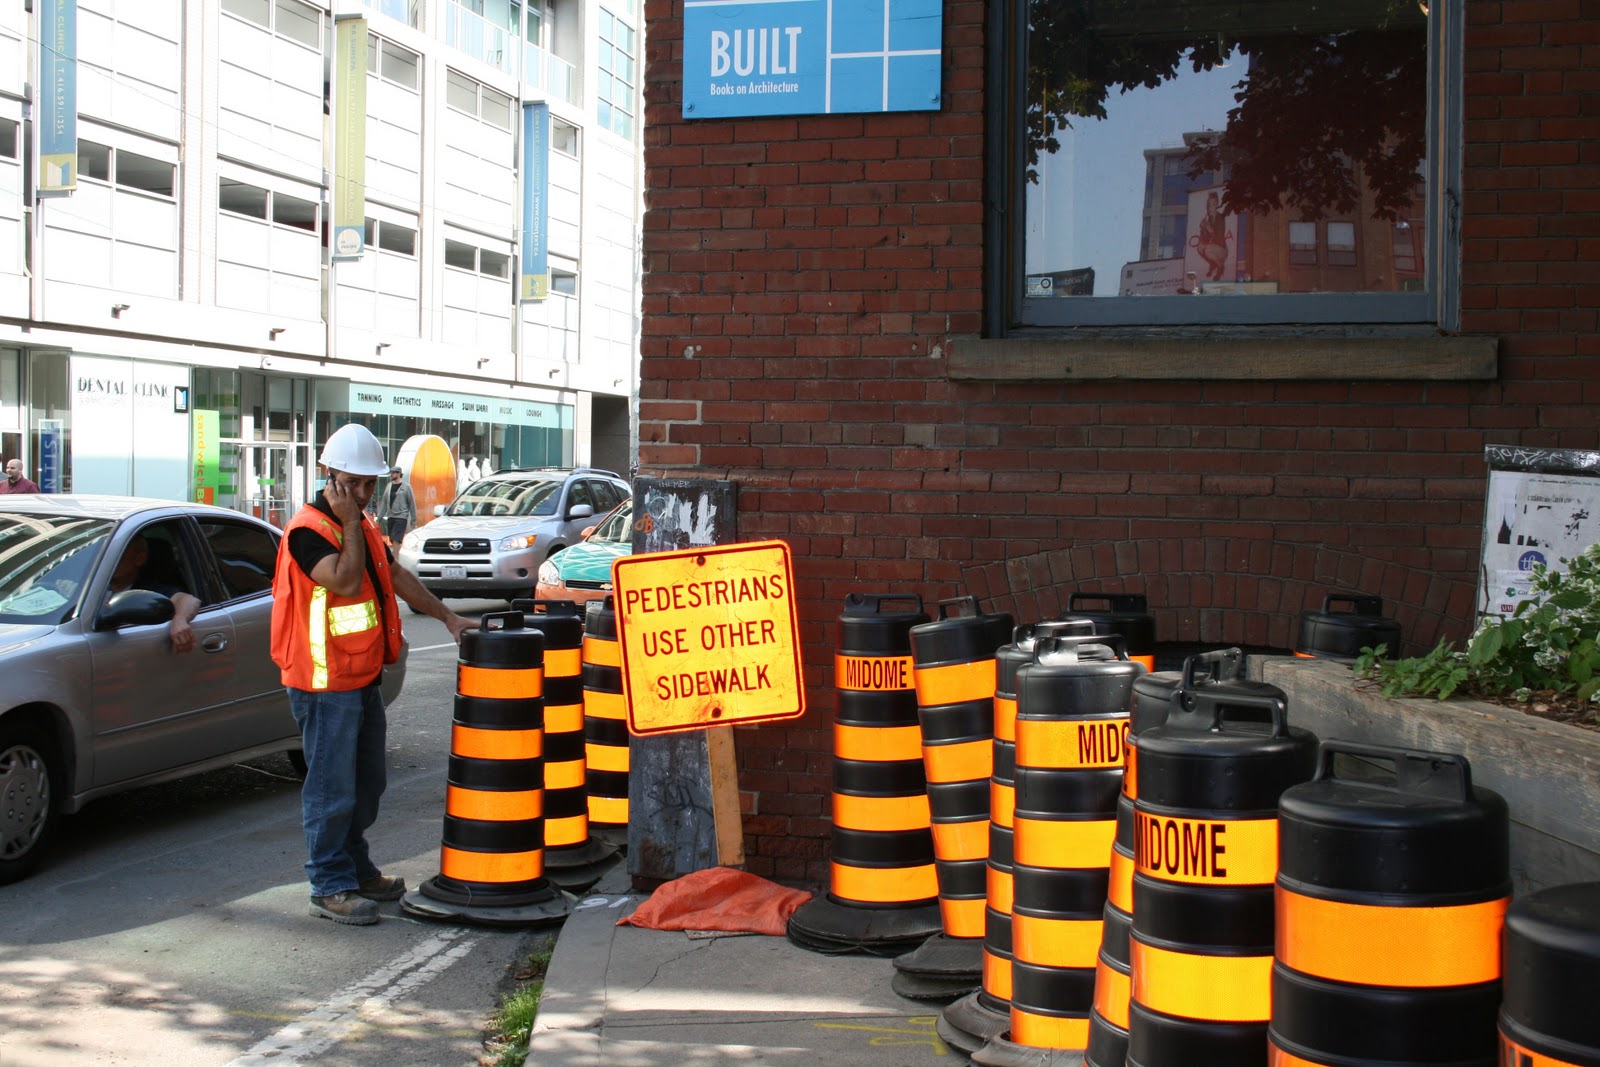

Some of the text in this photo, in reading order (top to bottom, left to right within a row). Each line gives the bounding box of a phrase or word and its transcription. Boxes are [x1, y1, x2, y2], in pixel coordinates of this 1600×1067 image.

[57, 15, 65, 52] CLINIC
[710, 26, 802, 77] BUILT
[710, 81, 799, 96] Books on Architecture
[77, 376, 172, 398] DENTAL CLINIC
[357, 392, 543, 418] TANNING AESTHETICS MASSAGE SWIM WEAR MUSIC LOUNGE
[625, 573, 784, 614] PEDESTRIANS
[642, 619, 776, 657] USE OTHER
[657, 664, 772, 701] SIDEWALK
[846, 659, 907, 689] MIDOME
[1134, 812, 1227, 878] MIDOME
